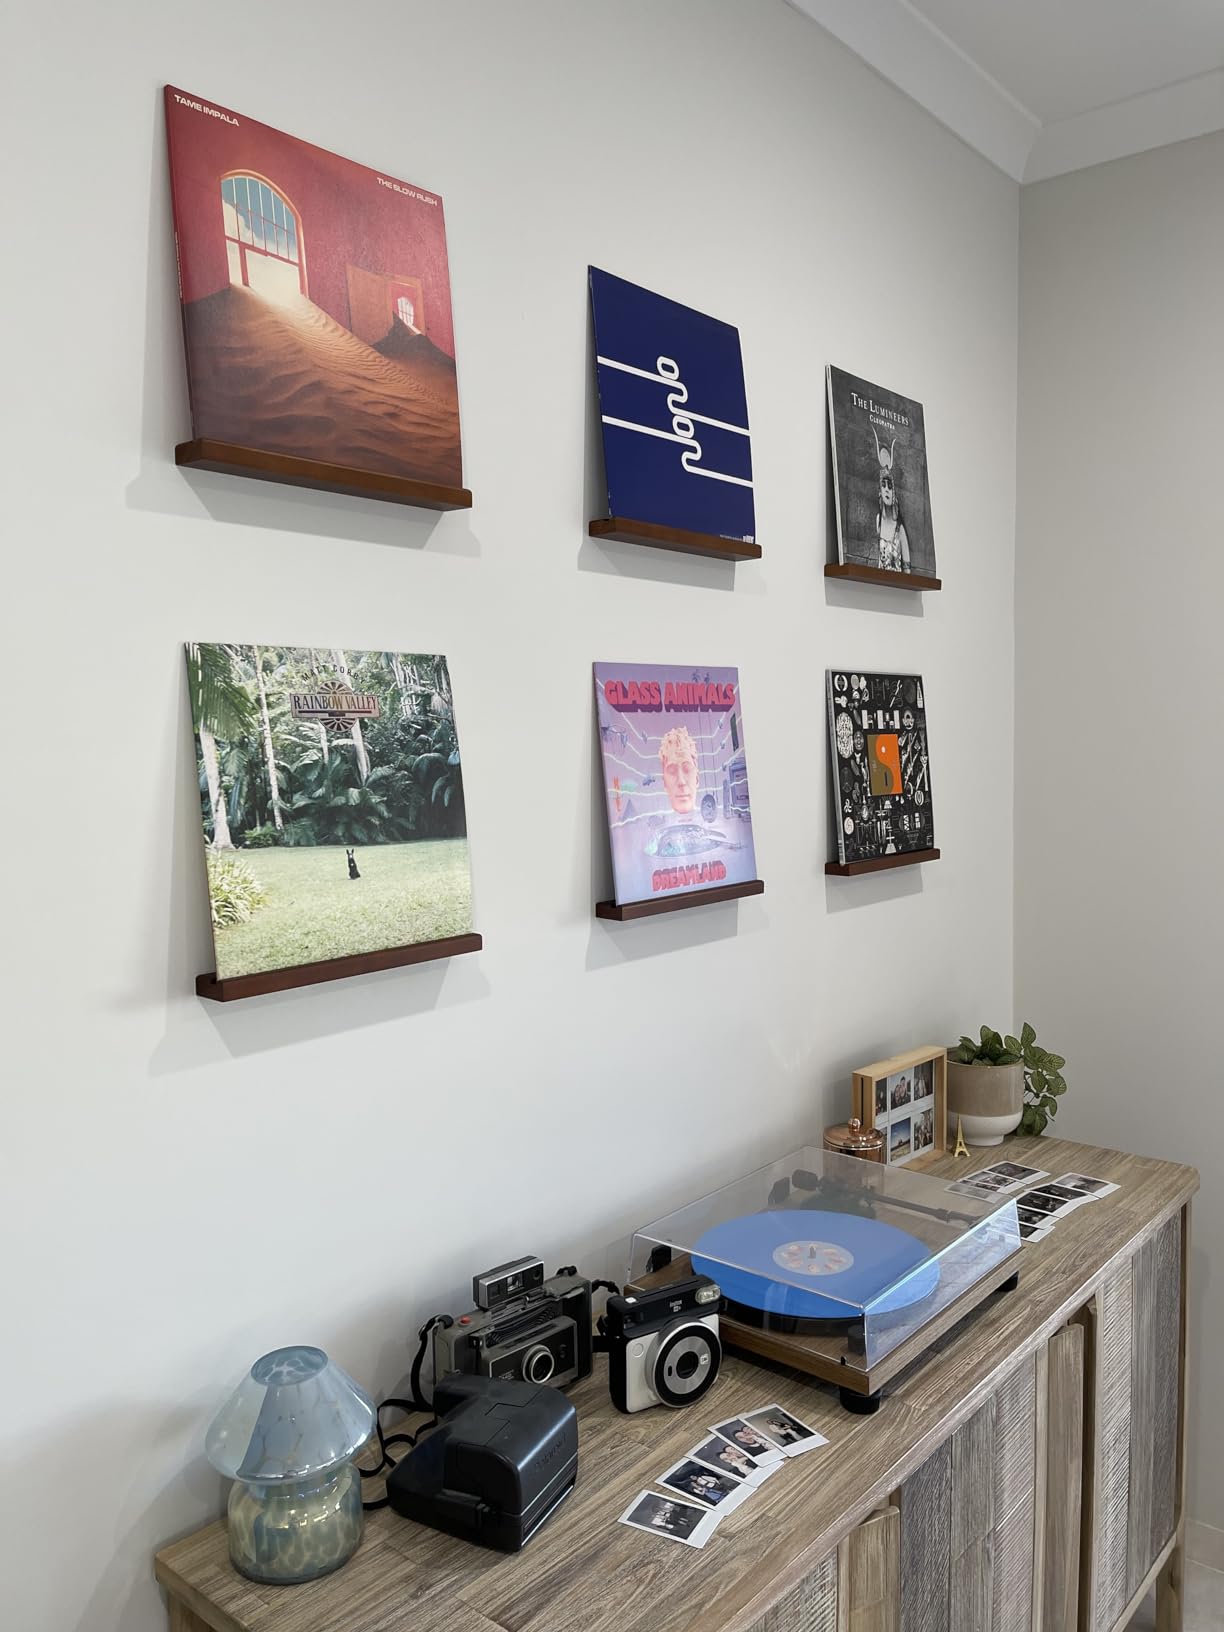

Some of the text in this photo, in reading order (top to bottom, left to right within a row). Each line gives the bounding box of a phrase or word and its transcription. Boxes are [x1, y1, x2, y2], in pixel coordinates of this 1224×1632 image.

[174, 94, 239, 126] TAME IMPALA
[377, 177, 438, 206] THE SLOW RUSH
[301, 664, 367, 684] MATT CORBY
[293, 695, 377, 710] RAINBOW VALLEY
[604, 680, 735, 712] GLASS ANIMALS
[652, 860, 727, 892] DREAMLAND
